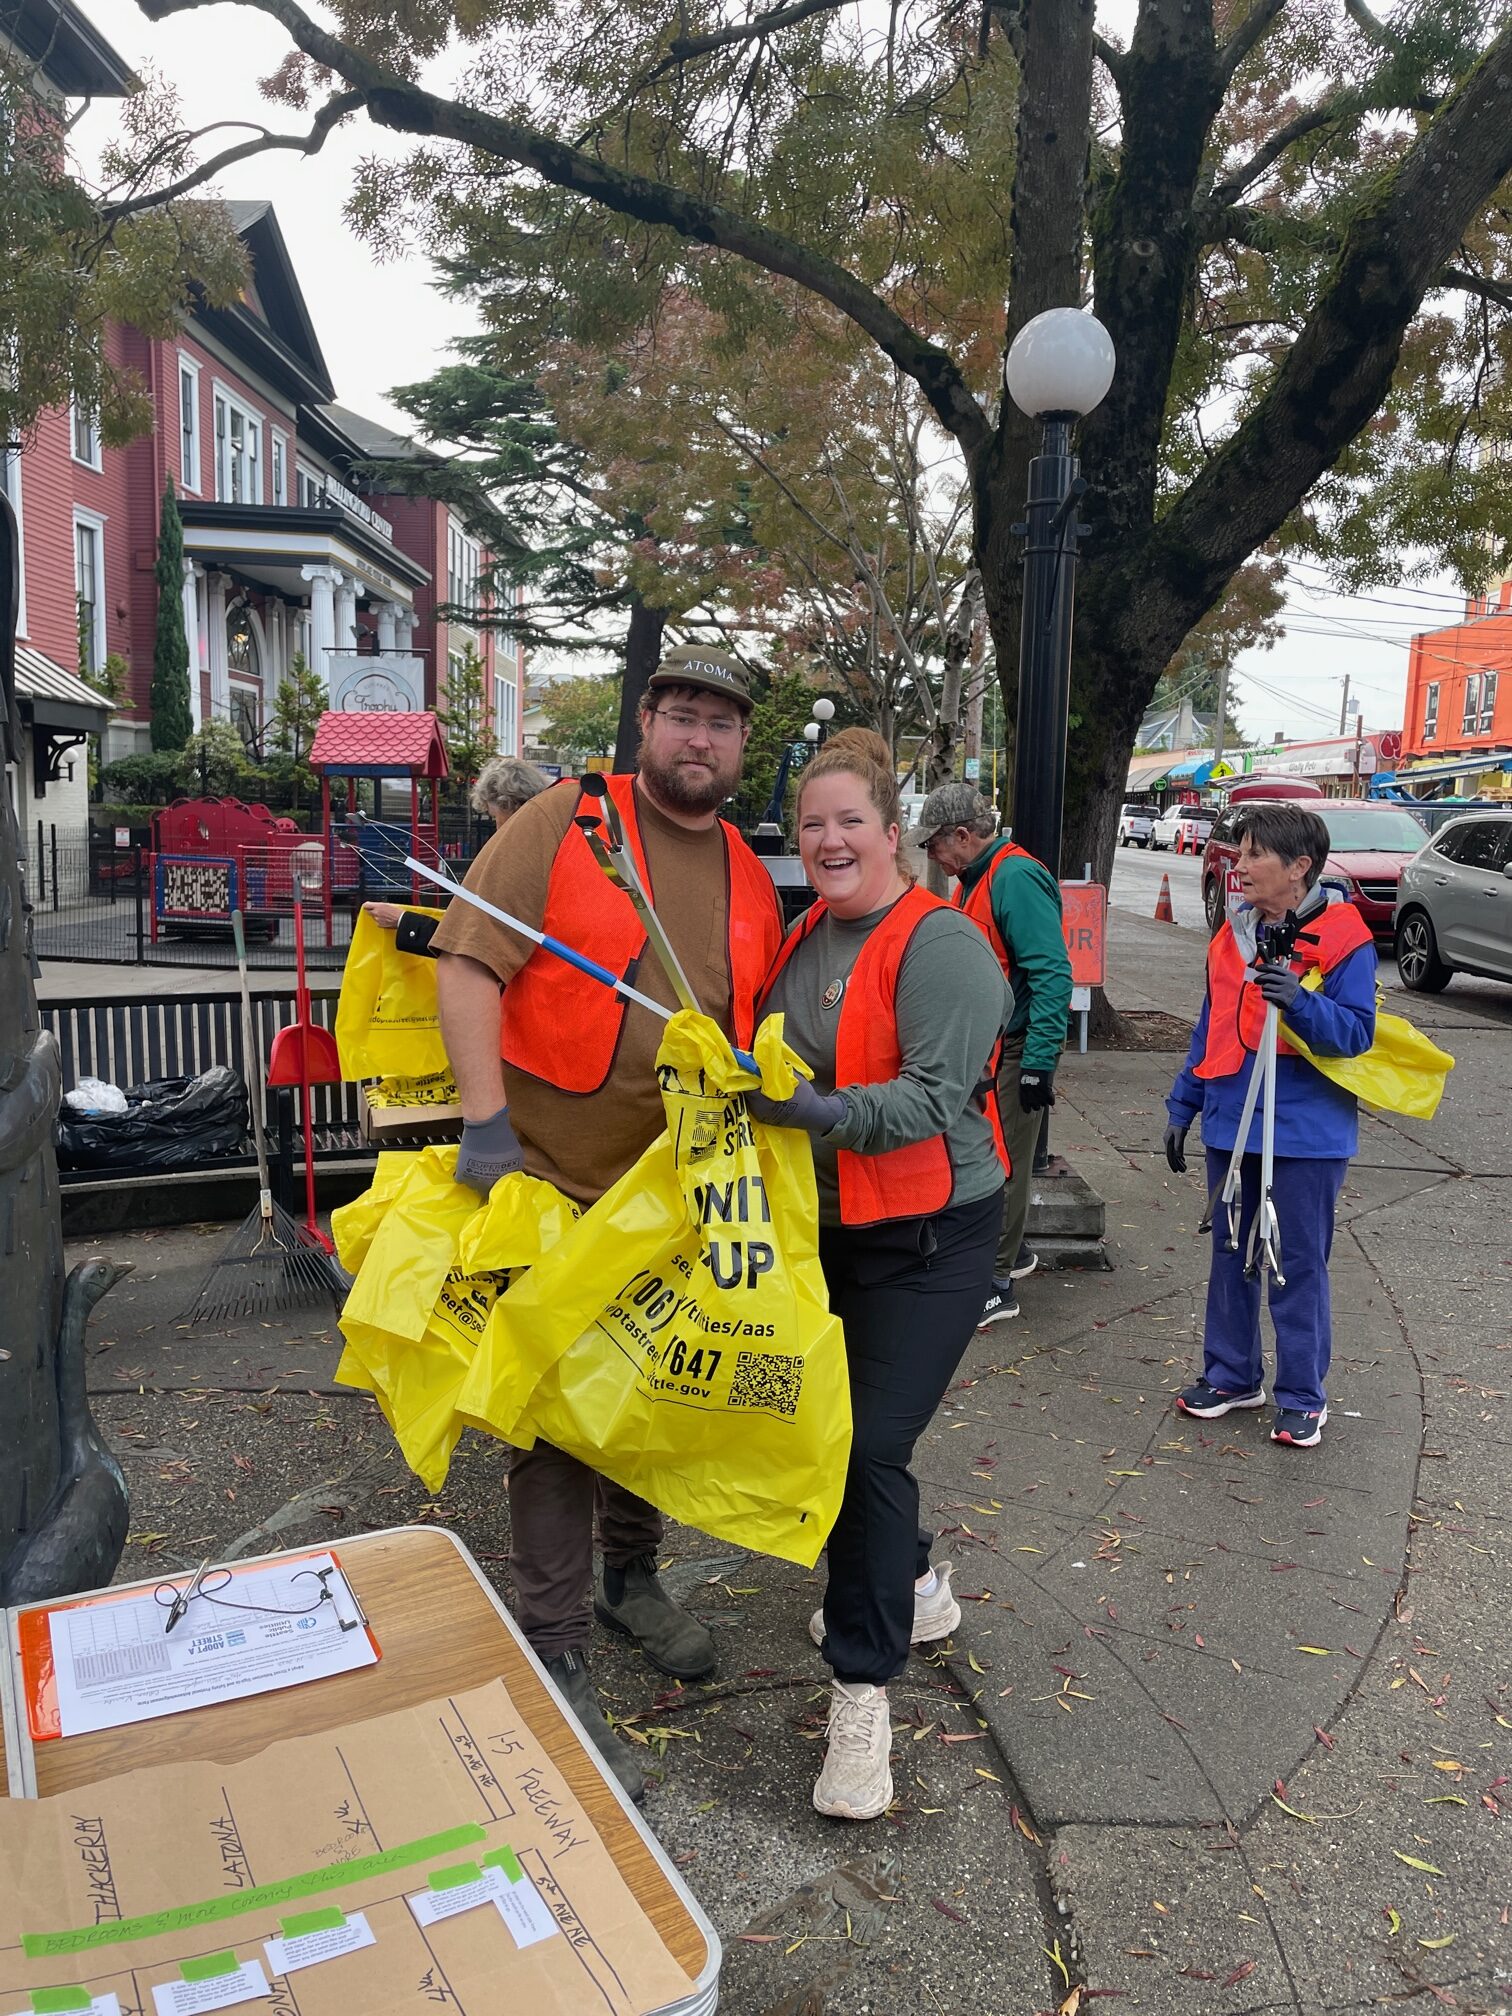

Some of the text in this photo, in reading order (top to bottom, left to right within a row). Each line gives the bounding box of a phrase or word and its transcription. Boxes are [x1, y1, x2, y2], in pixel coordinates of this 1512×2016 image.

[683, 660, 735, 683] ATOMA
[191, 1633, 223, 1647] STREET
[196, 1641, 225, 1654] ADOPT
[515, 1767, 590, 1859] FREEWAY
[209, 1816, 246, 1888] LATONA
[566, 1927, 592, 1948] NE
